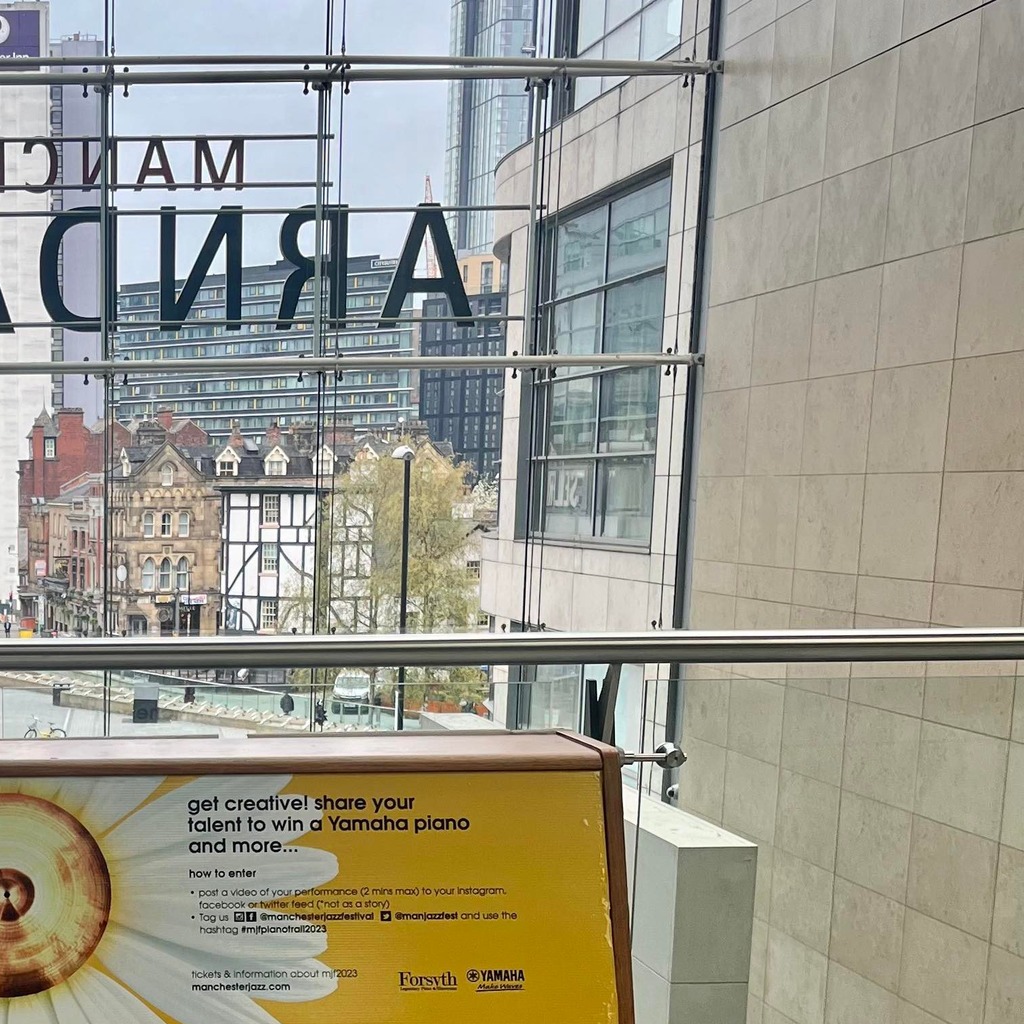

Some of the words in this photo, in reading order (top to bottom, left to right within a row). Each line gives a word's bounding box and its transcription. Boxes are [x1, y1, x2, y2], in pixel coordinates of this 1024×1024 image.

[187, 796, 219, 815] get
[224, 795, 308, 812] creative!
[314, 795, 367, 811] share
[372, 796, 415, 813] your
[187, 817, 242, 833] talent
[247, 816, 266, 832] to
[272, 816, 304, 832] win
[309, 819, 323, 832] a
[328, 815, 409, 831] Yamaha
[414, 815, 470, 834] piano
[188, 838, 226, 853] and
[232, 840, 298, 853] more...
[189, 869, 212, 878] how
[214, 869, 225, 878] to
[228, 869, 257, 878] enter
[198, 889, 219, 898] post
[230, 888, 257, 897] video
[259, 887, 270, 896] of
[272, 888, 292, 898] your
[294, 887, 358, 898] performance
[360, 886, 370, 897] (2
[372, 887, 393, 896] mins
[395, 887, 419, 897] max)
[422, 886, 432, 895] to
[434, 887, 455, 897] your
[199, 901, 246, 910] facebook
[260, 900, 289, 909] twitter
[292, 900, 314, 909] feed
[342, 901, 353, 909] as
[364, 900, 390, 910] story)
[199, 913, 216, 923] Tag
[219, 914, 229, 922] us
[260, 911, 375, 922] @manchesterjazzfestival
[394, 911, 458, 921] @manjazzfest
[461, 911, 481, 920] and
[483, 912, 499, 920] use
[501, 911, 518, 920] the
[200, 926, 239, 936] hashtag
[241, 924, 327, 935] #mjfpianotrail2023
[191, 970, 222, 979] tickets
[223, 969, 232, 979] &
[233, 969, 288, 978] information
[290, 969, 320, 978] about
[322, 968, 358, 979] mjf2023
[398, 971, 458, 988] Forsyth
[480, 969, 525, 982] YAMAHA
[191, 982, 291, 992] manchesterjazz.com
